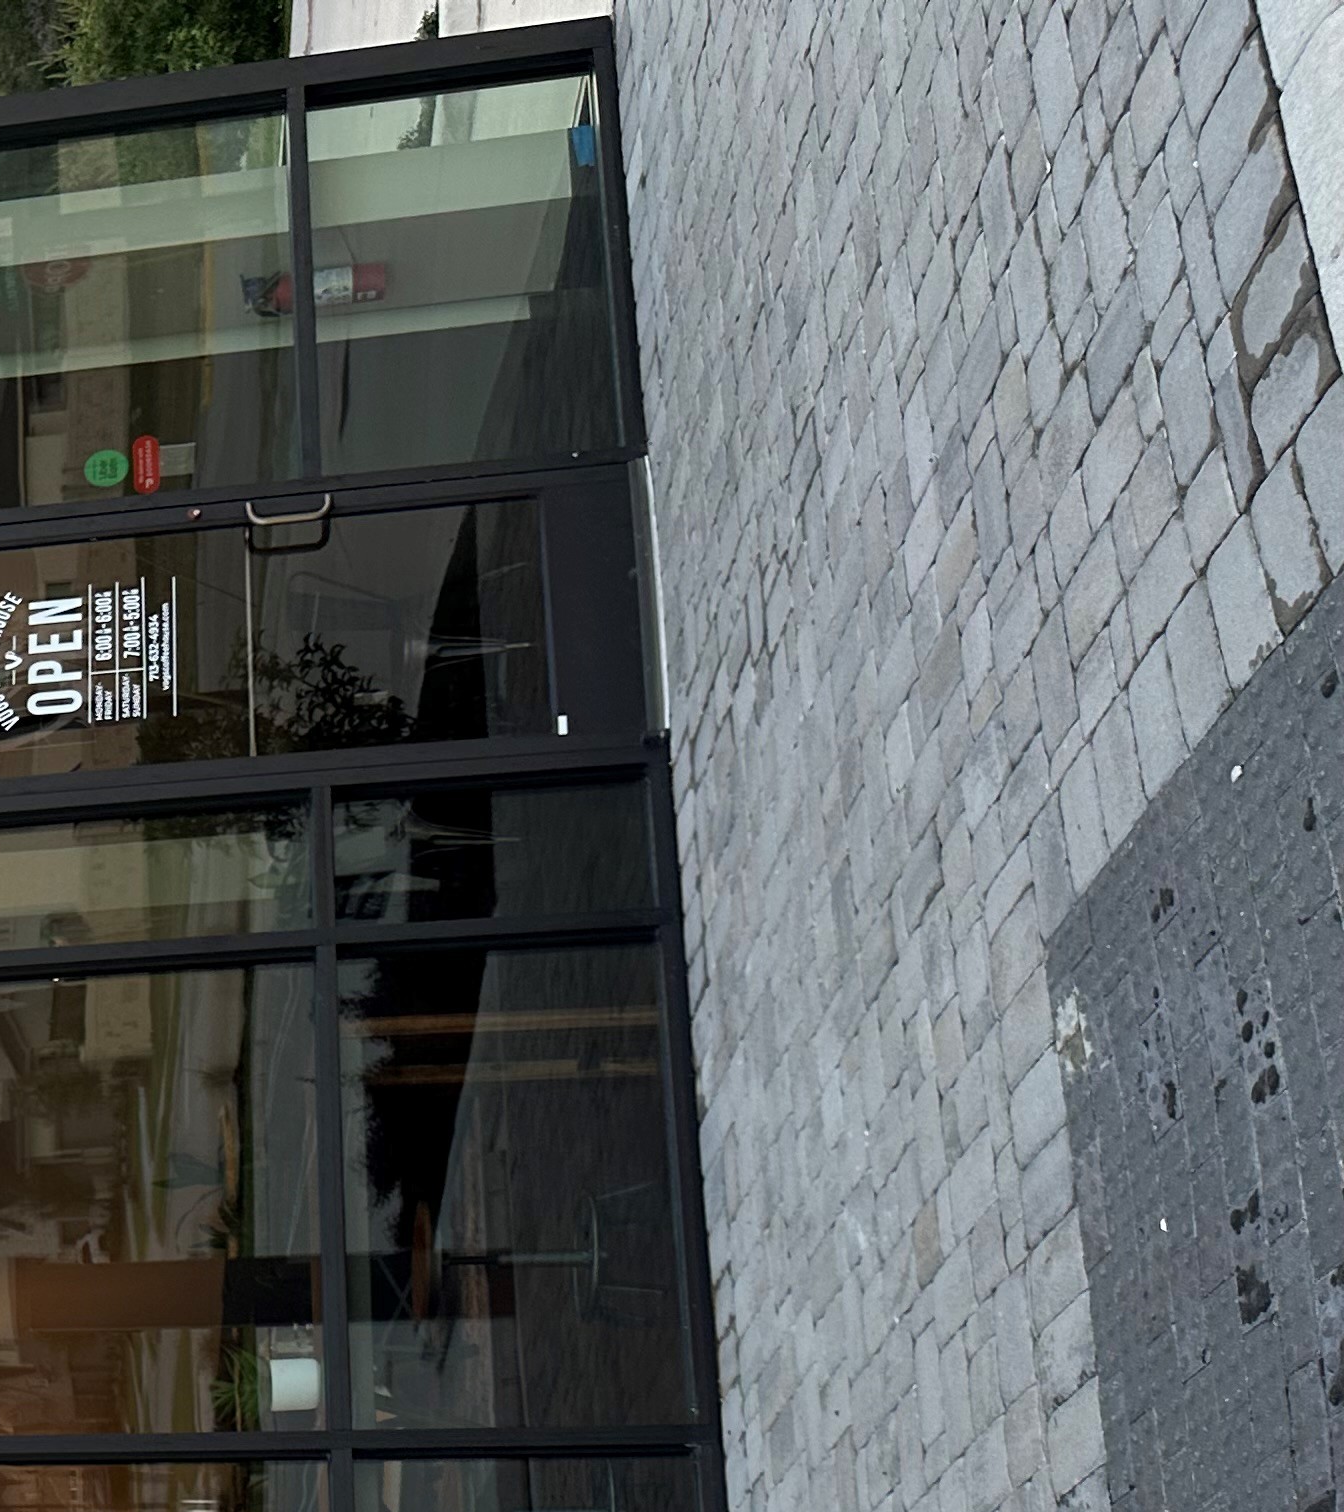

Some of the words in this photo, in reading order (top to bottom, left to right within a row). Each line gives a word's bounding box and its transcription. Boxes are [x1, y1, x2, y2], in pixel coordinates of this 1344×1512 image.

[26, 596, 84, 716] OPEN
[147, 613, 160, 682] 713-632-4934
[103, 690, 113, 720] FRIDAY
